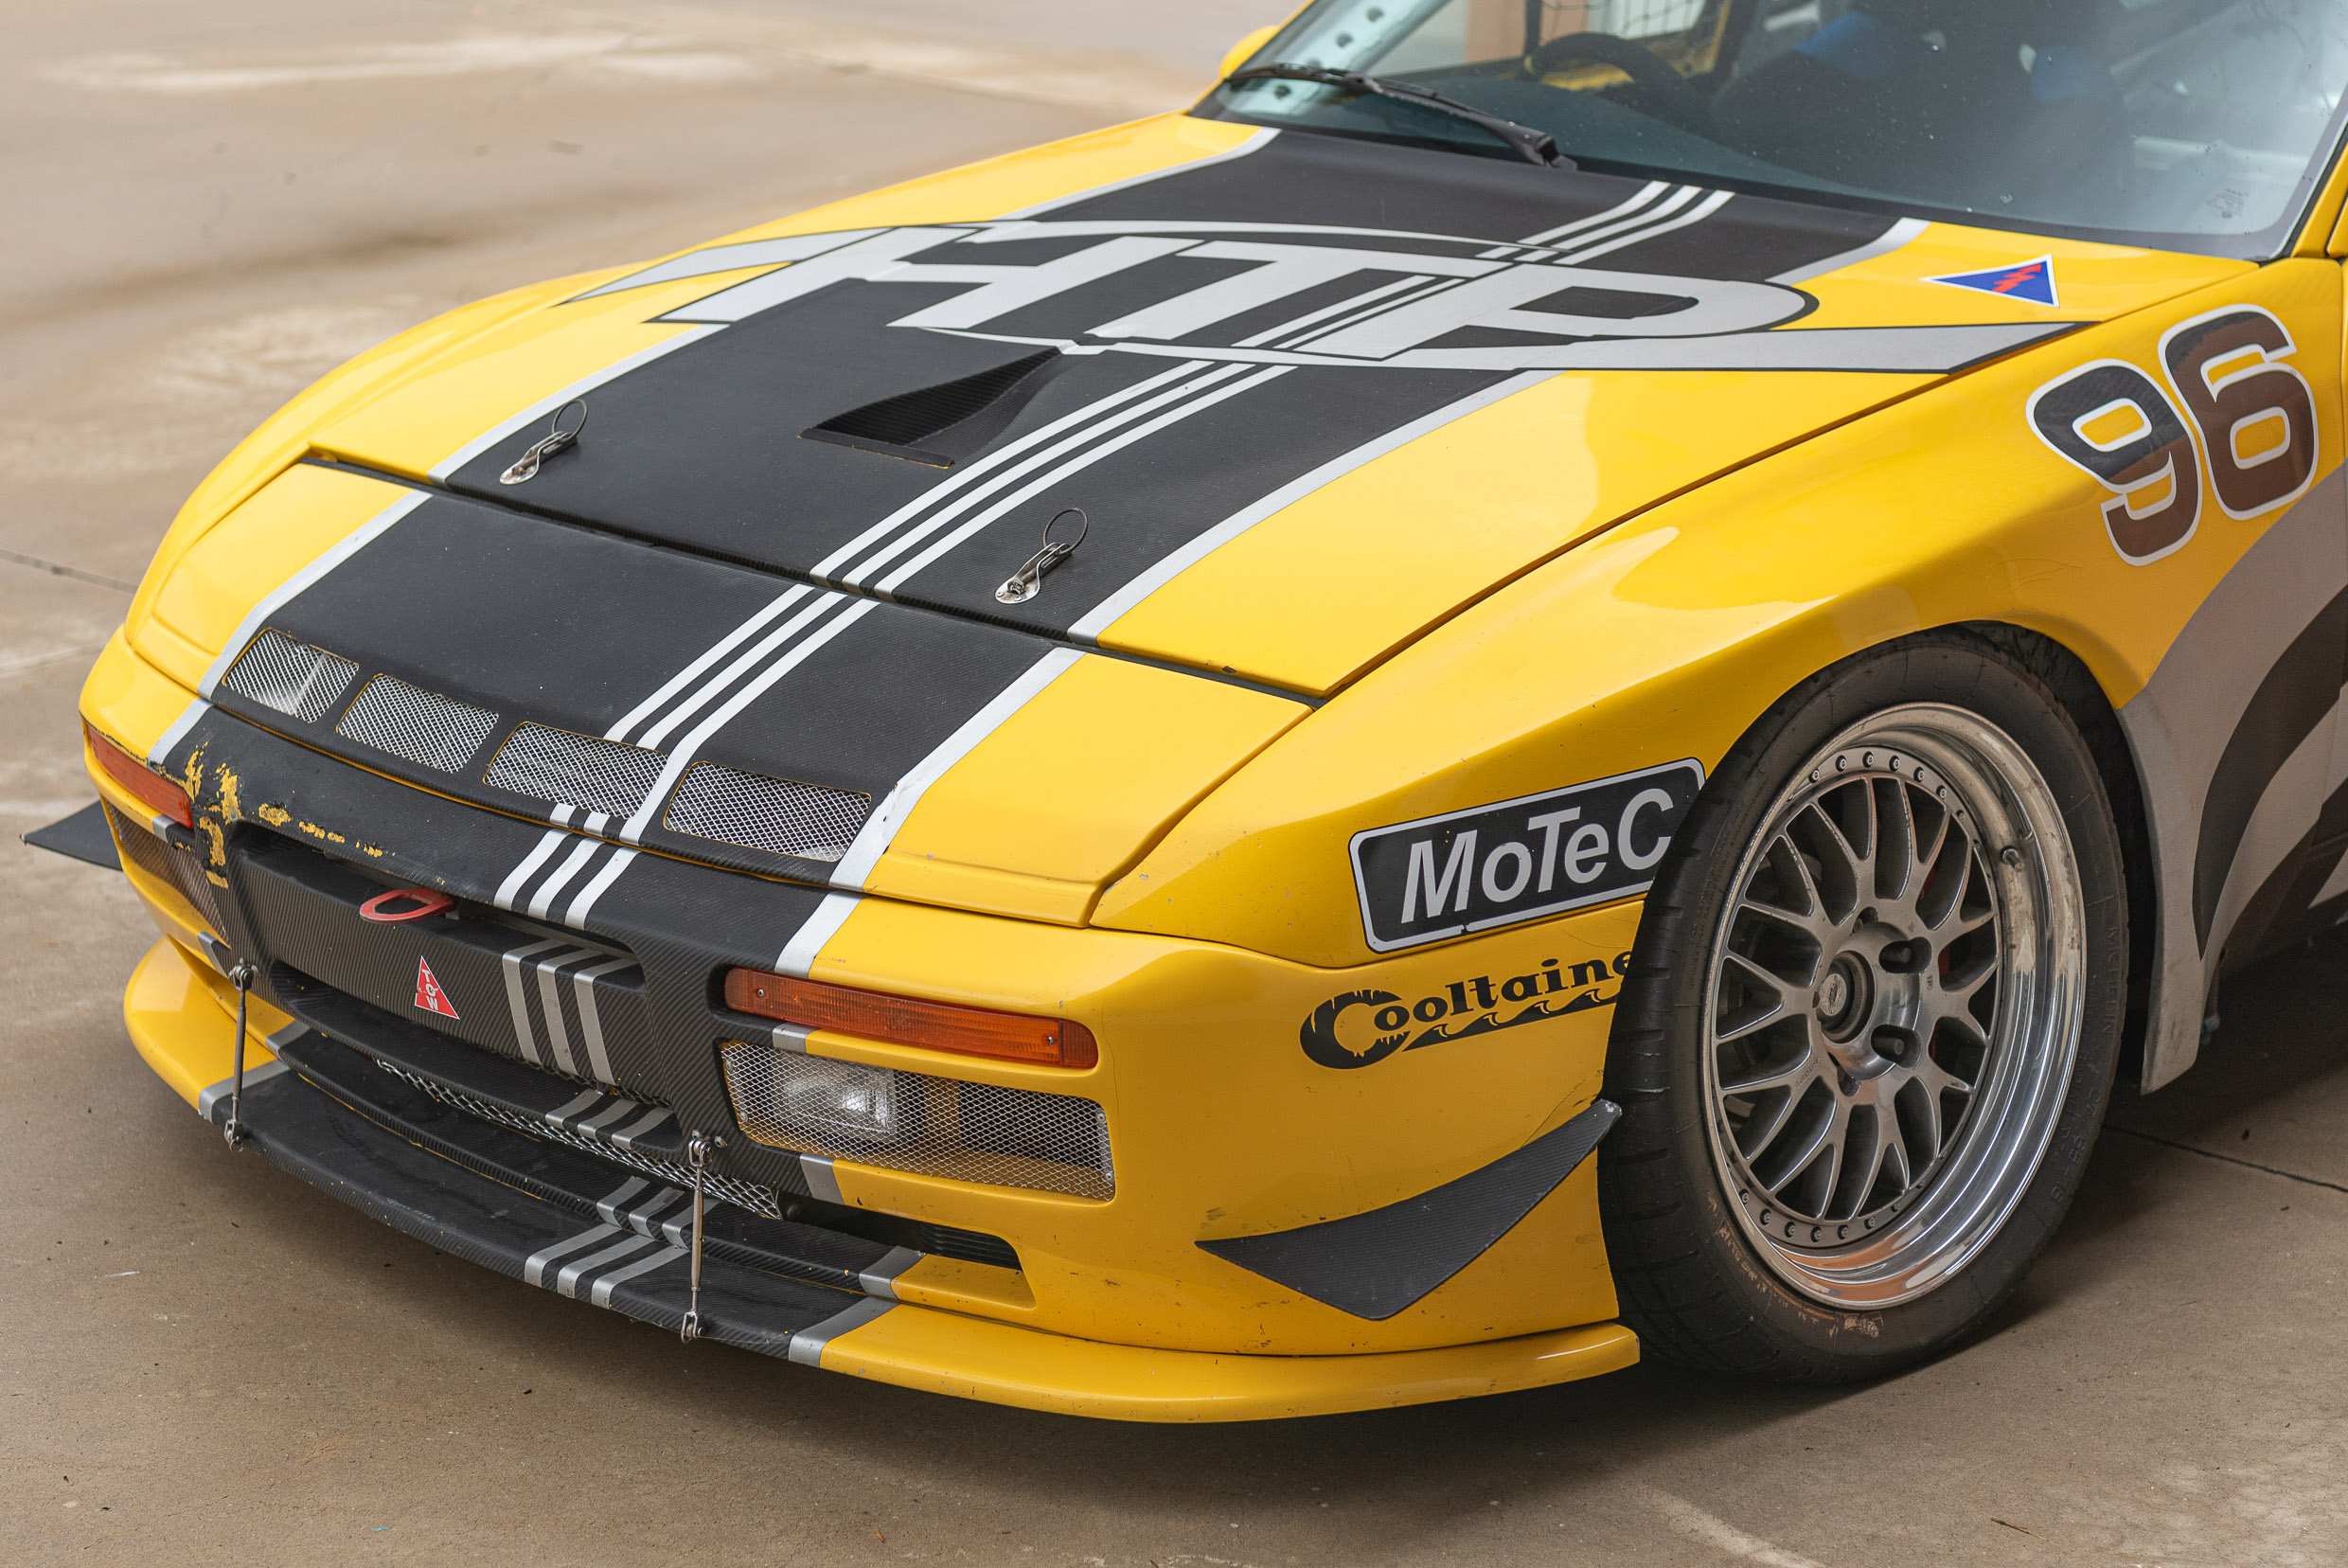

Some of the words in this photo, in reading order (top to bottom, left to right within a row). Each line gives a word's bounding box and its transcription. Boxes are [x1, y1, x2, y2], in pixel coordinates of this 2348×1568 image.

[658, 224, 1810, 362] HTP
[2026, 304, 2320, 566] 96
[1401, 788, 1674, 924] MoTeC
[420, 968, 439, 1011] TOW
[2103, 926, 2120, 1034] MICHELIN
